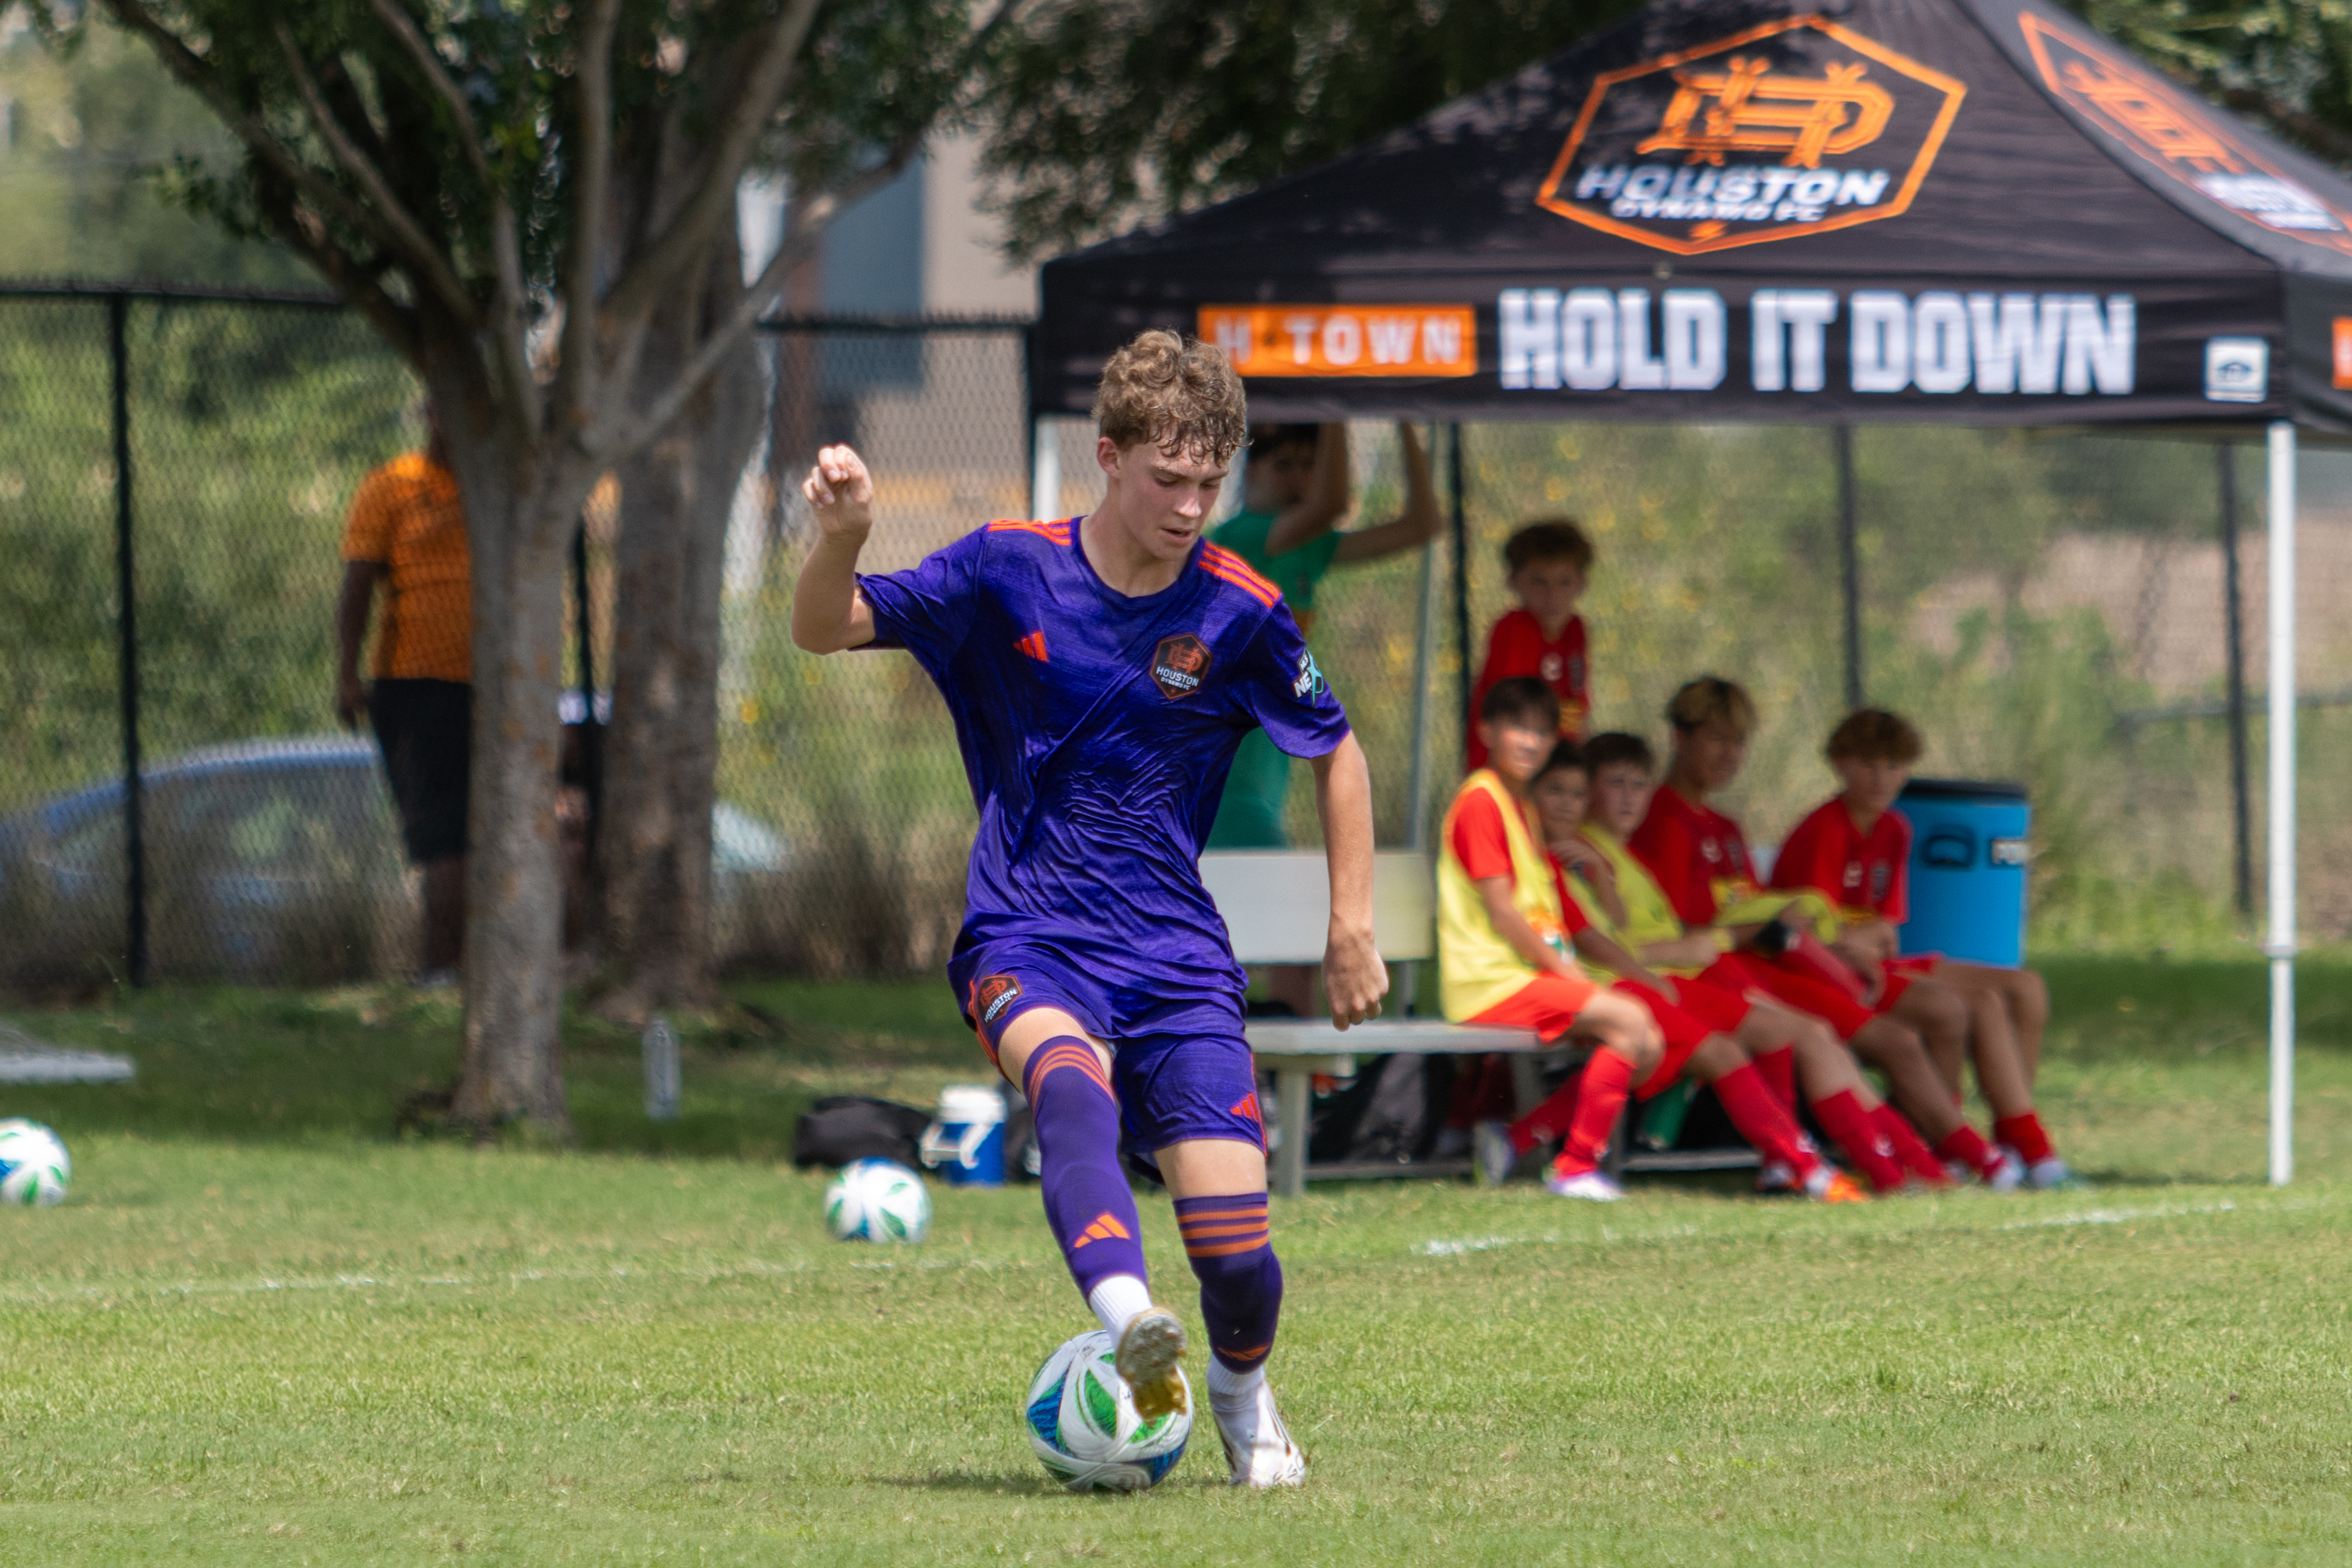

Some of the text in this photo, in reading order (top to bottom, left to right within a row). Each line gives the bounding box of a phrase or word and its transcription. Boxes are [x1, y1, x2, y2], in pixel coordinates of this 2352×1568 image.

[1575, 164, 1890, 206] HOUSTON
[1283, 314, 1463, 366] TOWN
[1498, 287, 2136, 394] HOLD IT DOWN
[1156, 666, 1199, 687] HOUSTON
[984, 988, 1018, 1023] HOUSTON
